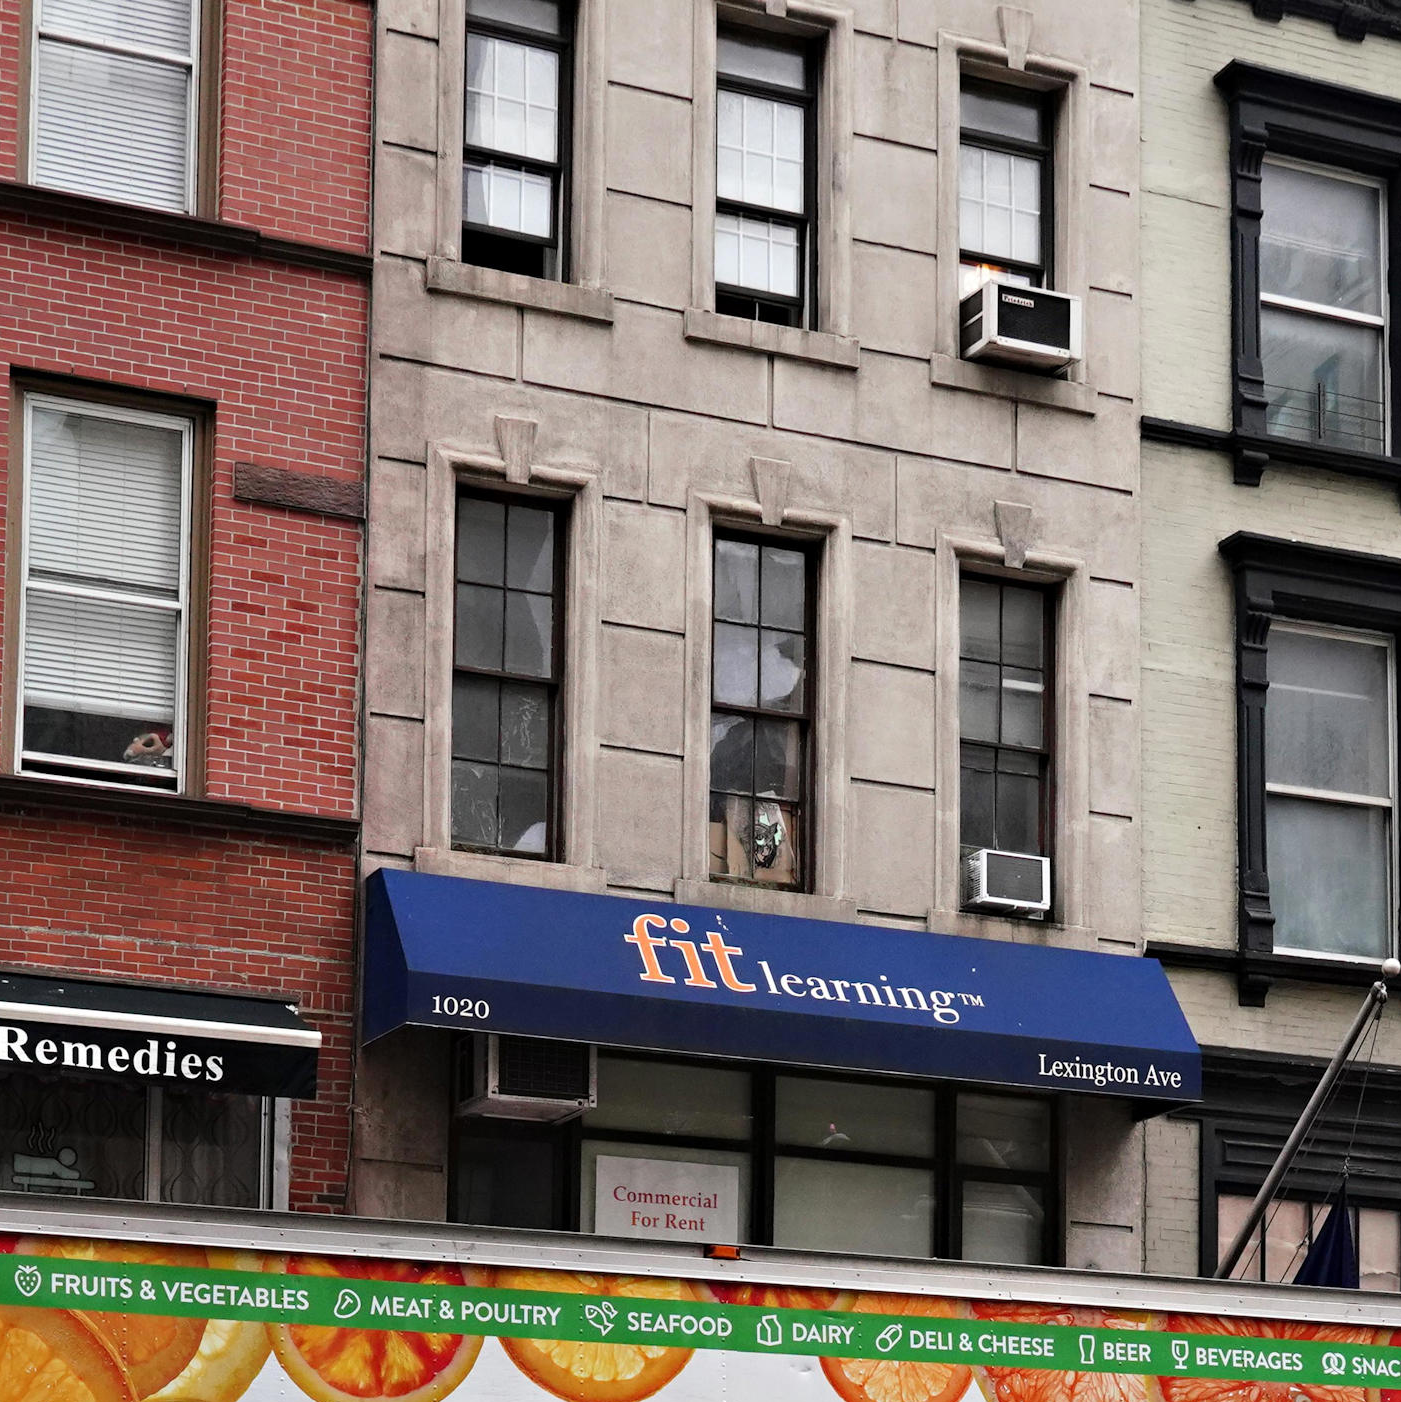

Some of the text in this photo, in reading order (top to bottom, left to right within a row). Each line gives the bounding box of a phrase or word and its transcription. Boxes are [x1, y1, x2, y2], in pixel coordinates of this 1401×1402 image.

[624, 914, 757, 995] fit
[431, 995, 489, 1020] 1020
[1038, 1053, 1182, 1089] Lexington Ave
[613, 1186, 718, 1208] Commercial
[632, 1211, 704, 1231] For Rent
[50, 1272, 309, 1310] FRUITS & VEGETABLES
[369, 1296, 562, 1326] MEAT & POULTRY
[627, 1312, 732, 1337] SEAFOOD
[792, 1323, 854, 1345] DAIRY
[909, 1330, 1054, 1358] DELI & CHEESE
[1103, 1341, 1151, 1362] BEER
[1195, 1348, 1302, 1372] BEVERAGES
